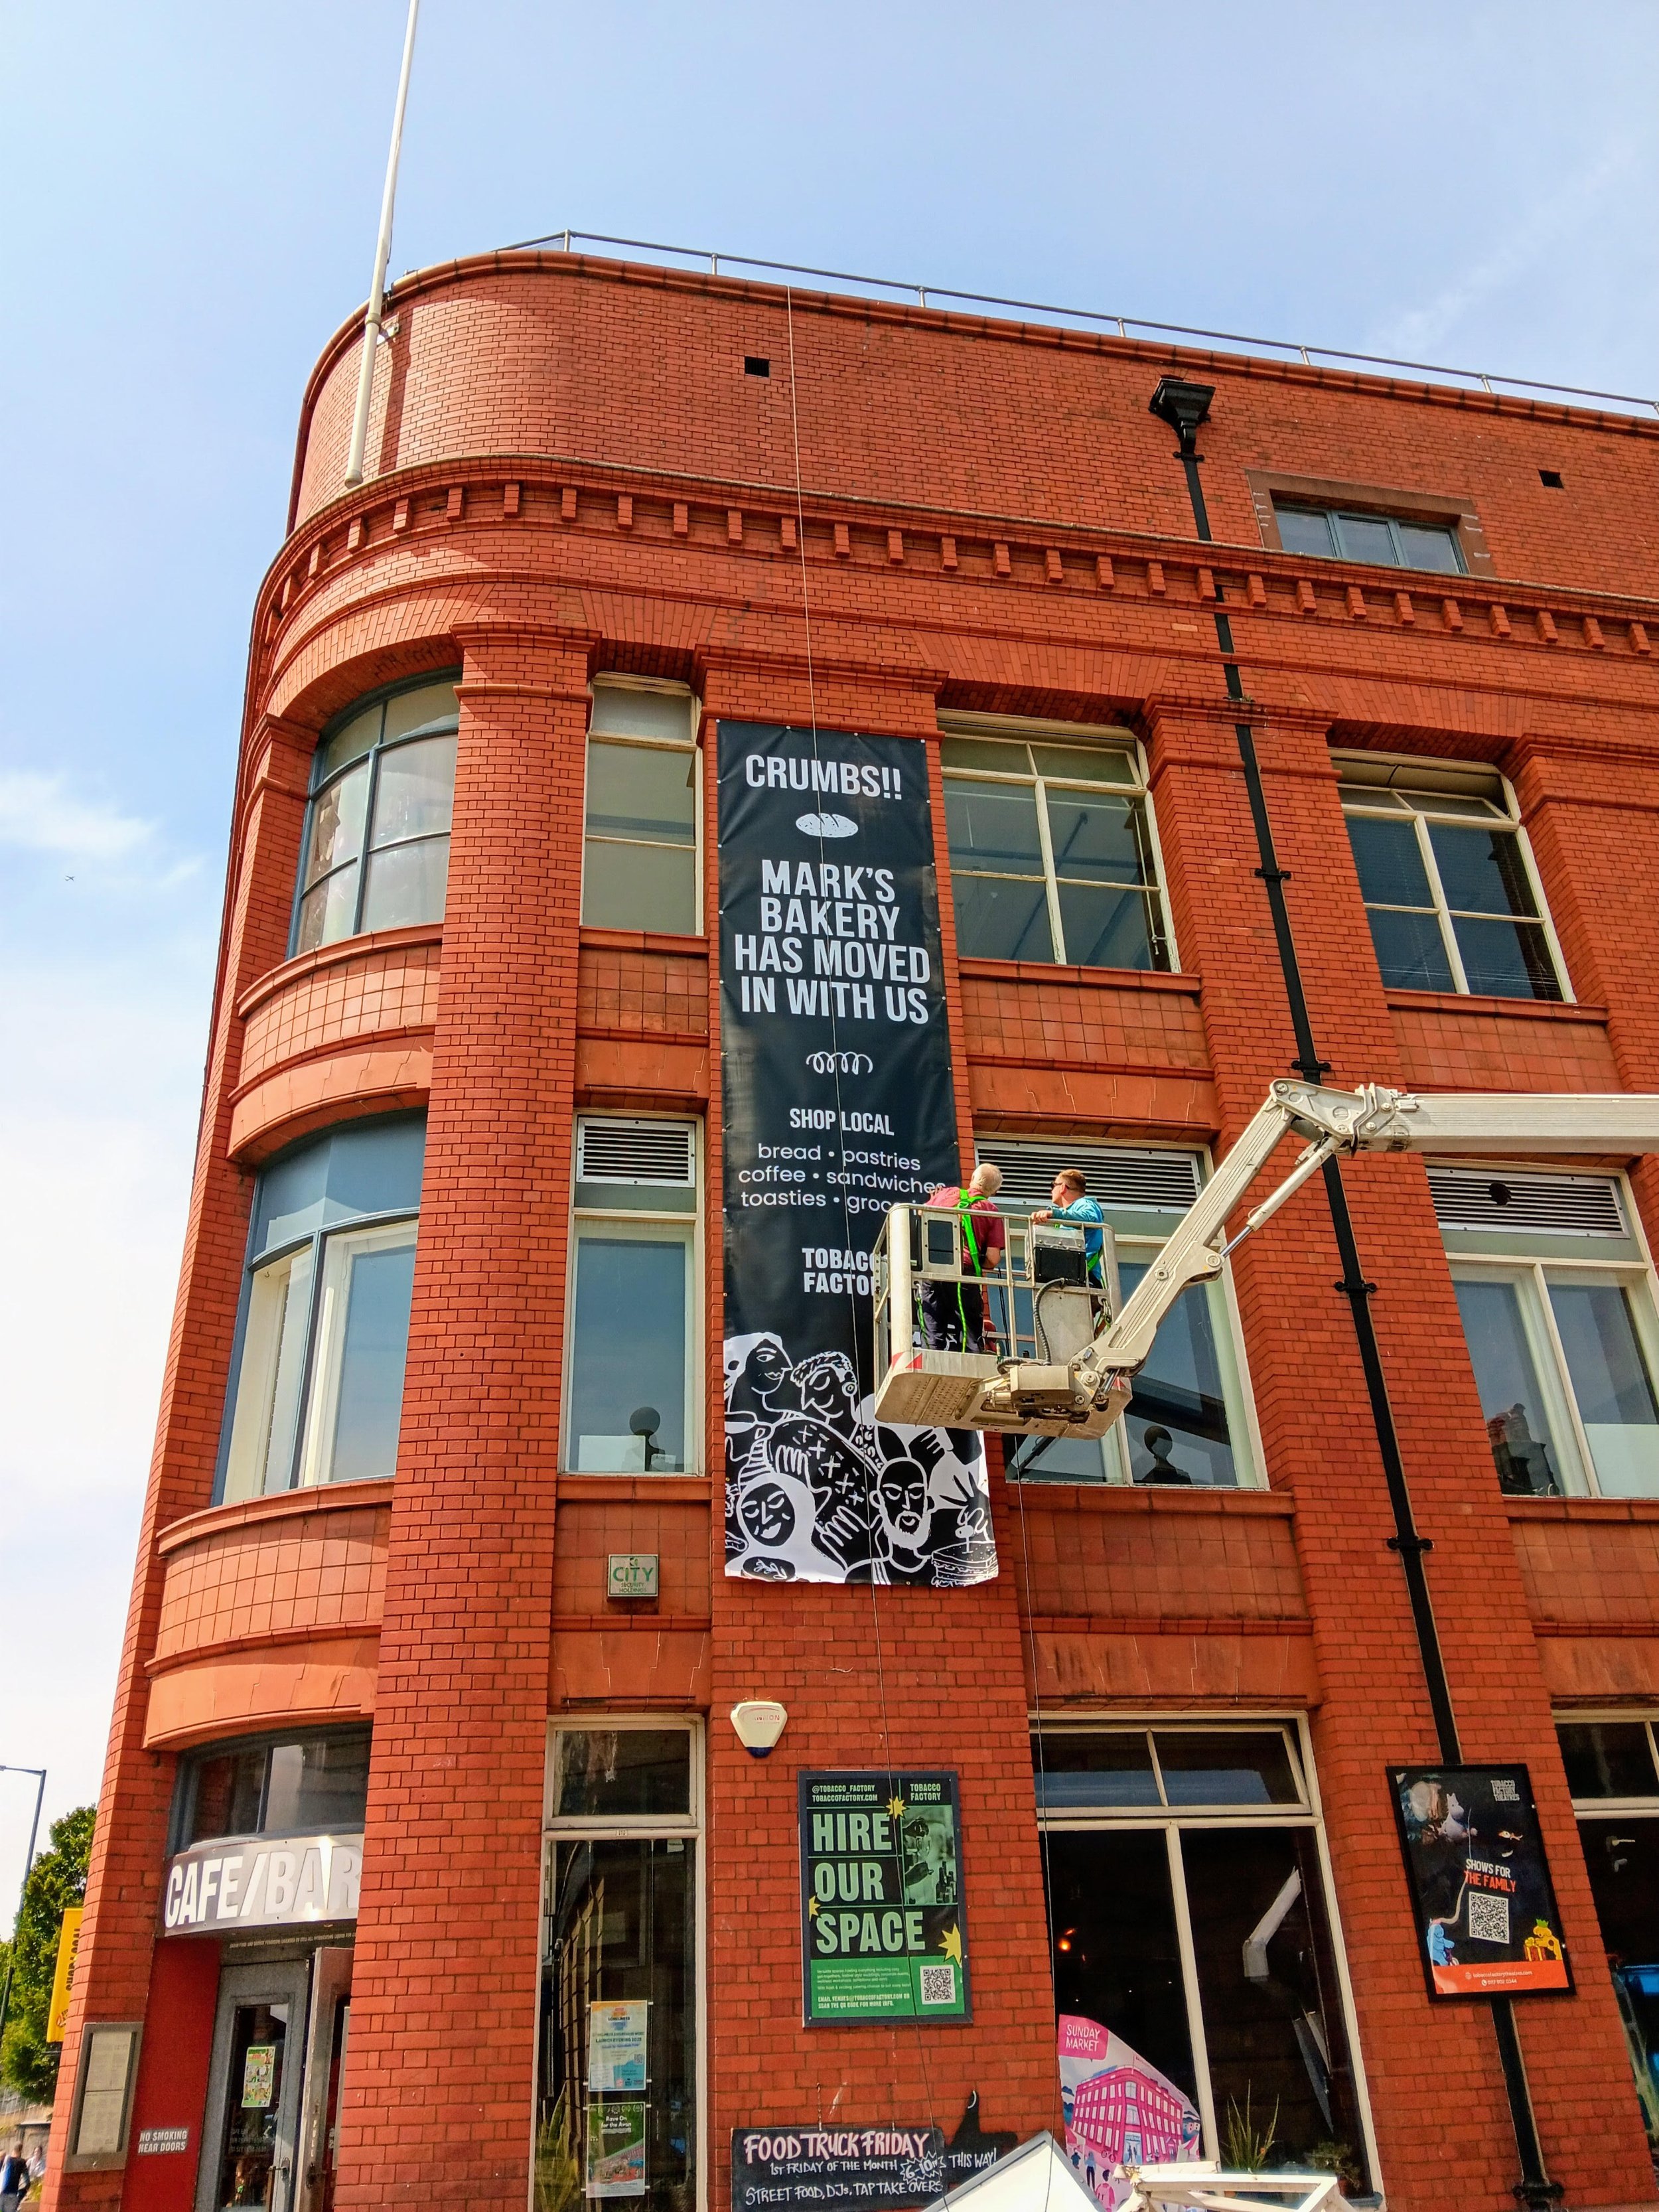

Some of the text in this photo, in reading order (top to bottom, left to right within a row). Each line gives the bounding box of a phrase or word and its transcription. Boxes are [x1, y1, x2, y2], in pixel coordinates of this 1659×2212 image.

[746, 754, 902, 800] CRUMBS!!
[762, 859, 896, 903] MARK'S
[760, 897, 900, 940] BAKERY
[735, 933, 930, 984] HAS MOVED
[741, 976, 930, 1025] IN WITH US
[790, 1108, 895, 1136] SHOP LOCAL
[758, 1143, 921, 1171] bread pastries
[738, 1165, 806, 1184] coffee
[741, 1189, 827, 1207] toasties
[802, 1248, 876, 1273] TOBAC
[803, 1272, 875, 1296] FACTO
[613, 1567, 654, 1582] CITY
[812, 1785, 875, 1794] @TOBACCO_FACTORY
[812, 1794, 878, 1803] TOBACCOFACTORY.COM
[910, 1783, 941, 1792] TOBACCO
[910, 1792, 941, 1801] FACTORY
[812, 1812, 892, 1852] HIRE
[1466, 1858, 1511, 1879] SHOWS FOR
[165, 1844, 362, 1928] CAFE/BAR
[814, 1862, 884, 1903] OUR
[1464, 1870, 1516, 1893] THE FAMILY
[816, 1911, 926, 1954] SPACE
[1066, 2024, 1100, 2039] SUNDAY
[1066, 2036, 1099, 2051] MARKET
[139, 2130, 188, 2142] NO SMOKING
[743, 2130, 930, 2165] FOOD TRUCK FRIDAY
[138, 2142, 186, 2154] NEAR DOORS
[948, 2146, 997, 2168] THIS WAY!
[770, 2160, 897, 2175] 1ST FRIDAY OF THE MONTH
[745, 2187, 793, 2206] STREET
[794, 2185, 826, 2200] FOOD,
[853, 2182, 876, 2196] TAP
[876, 2181, 906, 2195] TAKE
[908, 2180, 943, 2193] OVERS
